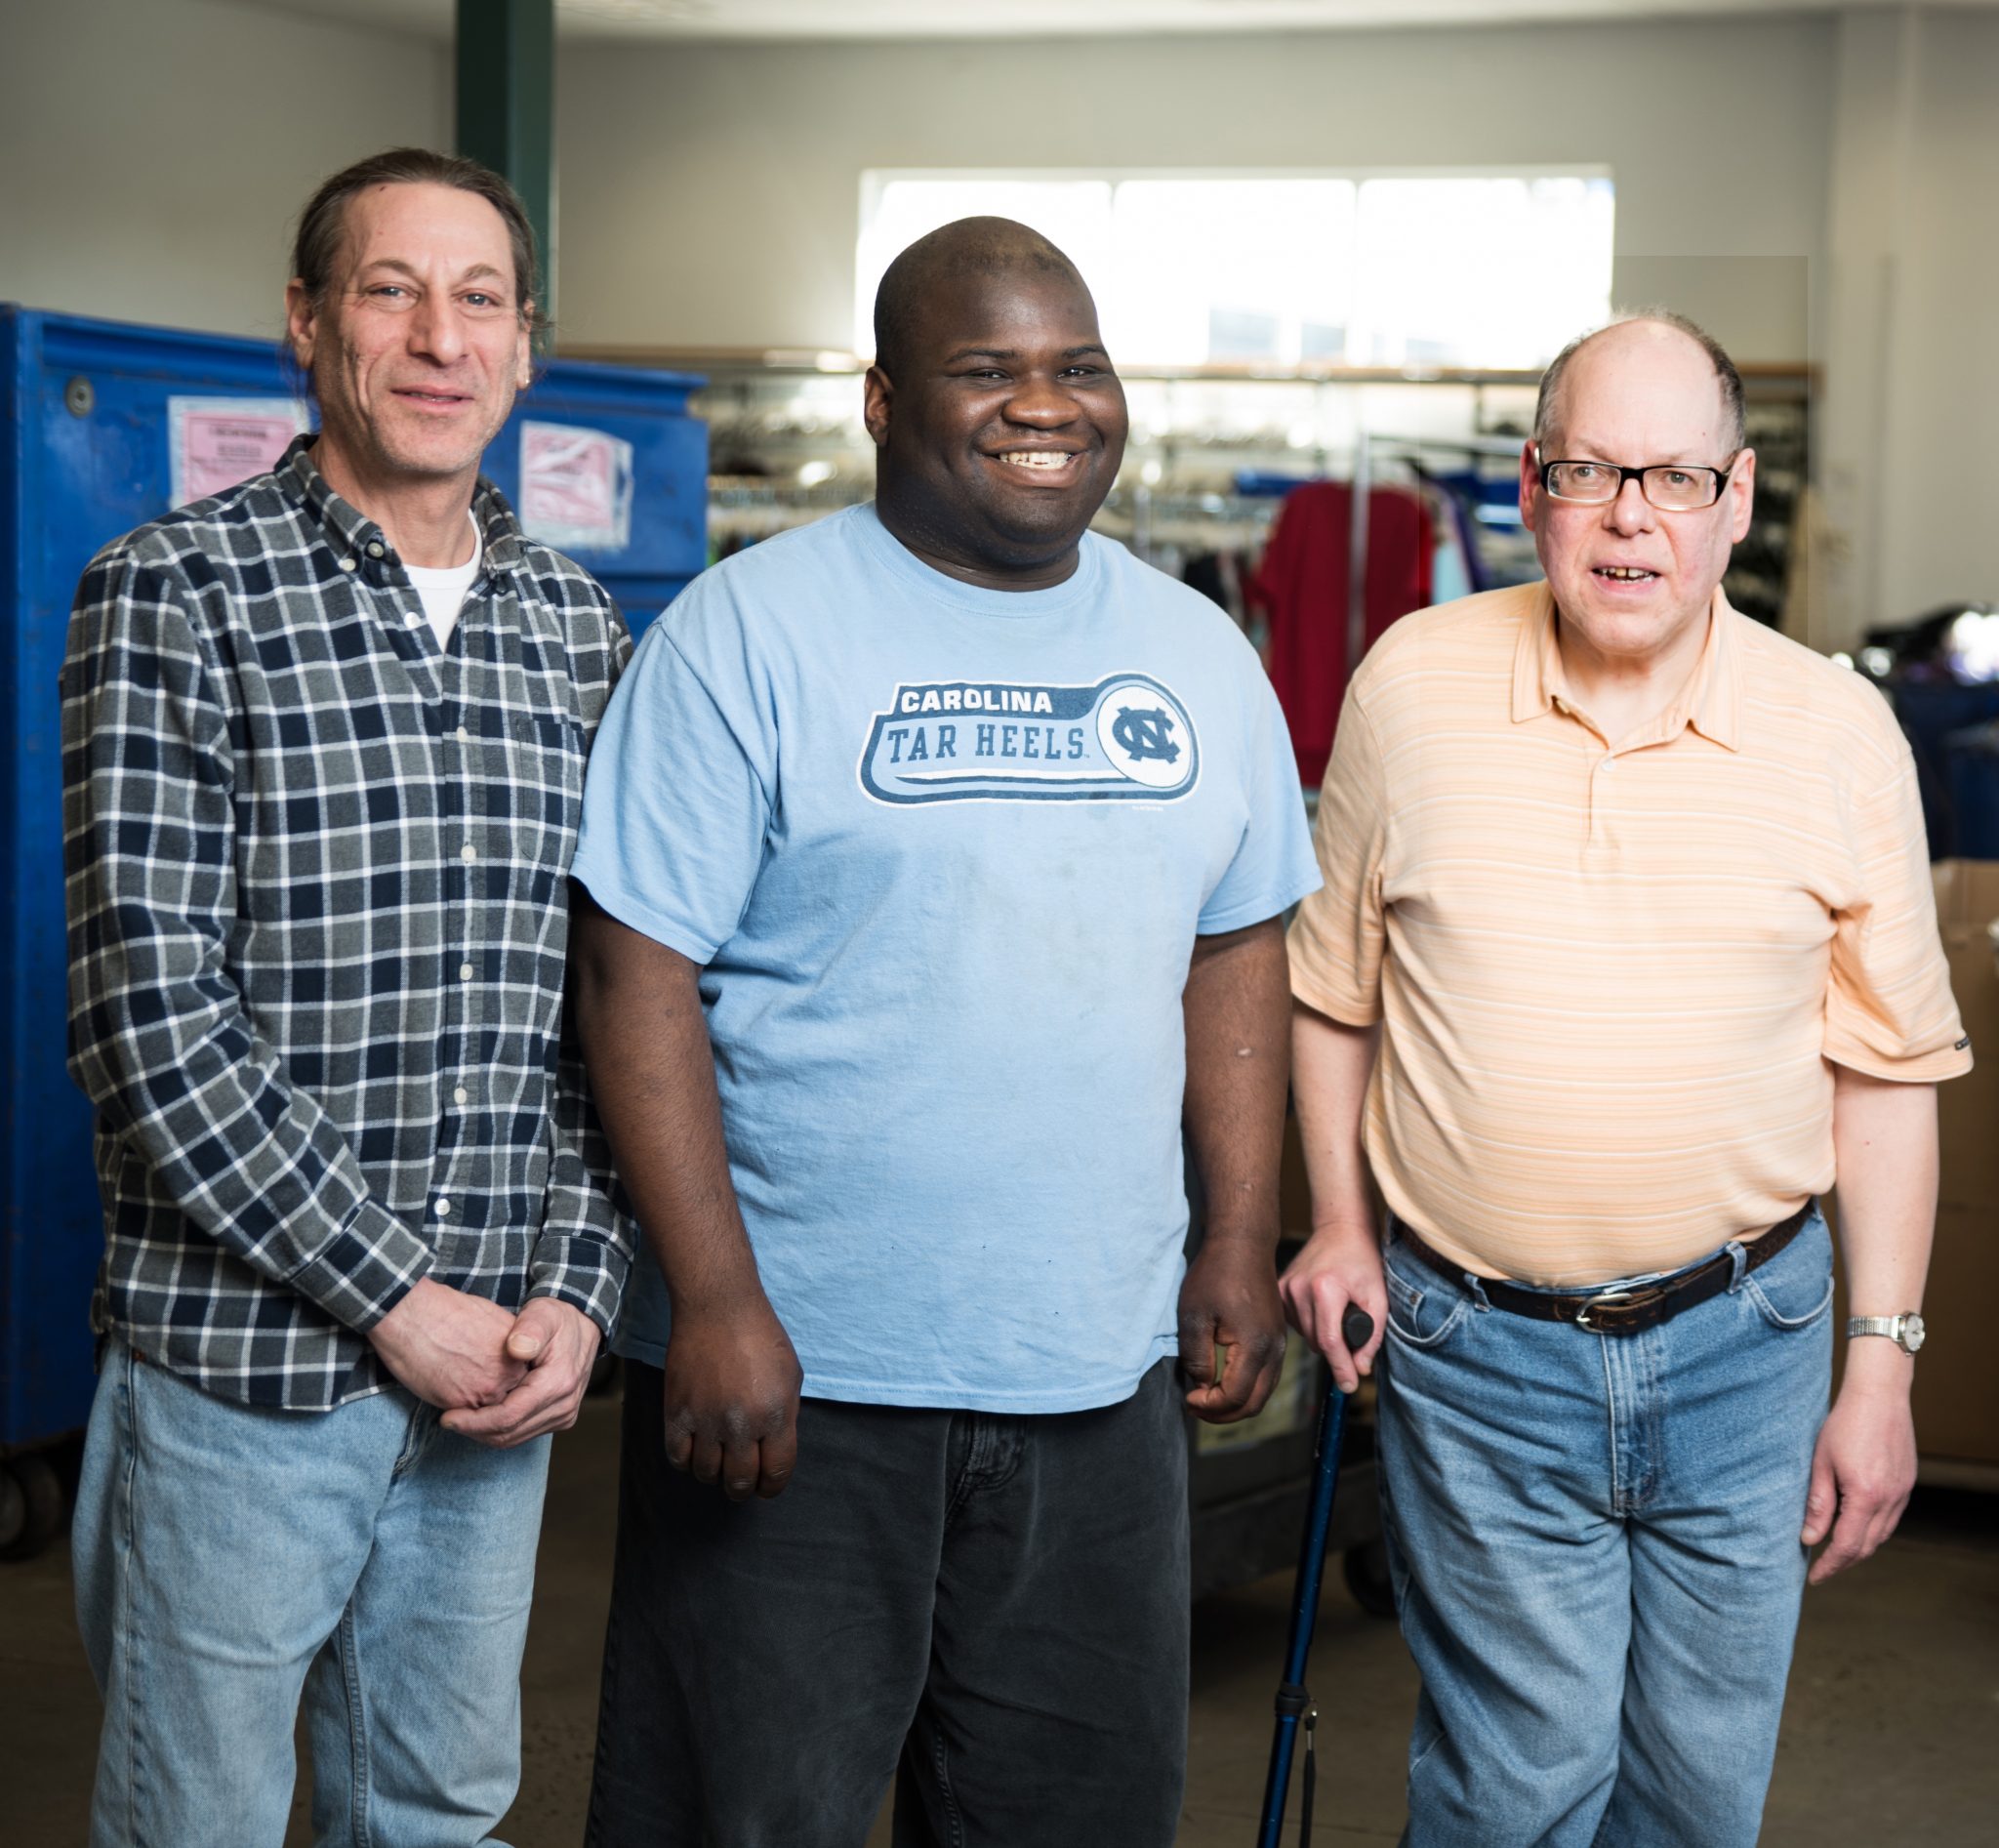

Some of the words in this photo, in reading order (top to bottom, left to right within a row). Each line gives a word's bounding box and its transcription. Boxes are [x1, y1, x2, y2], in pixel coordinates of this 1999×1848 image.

[902, 689, 1053, 714] CAROLINA
[888, 724, 957, 763] TAR
[975, 723, 1084, 760] HEELS
